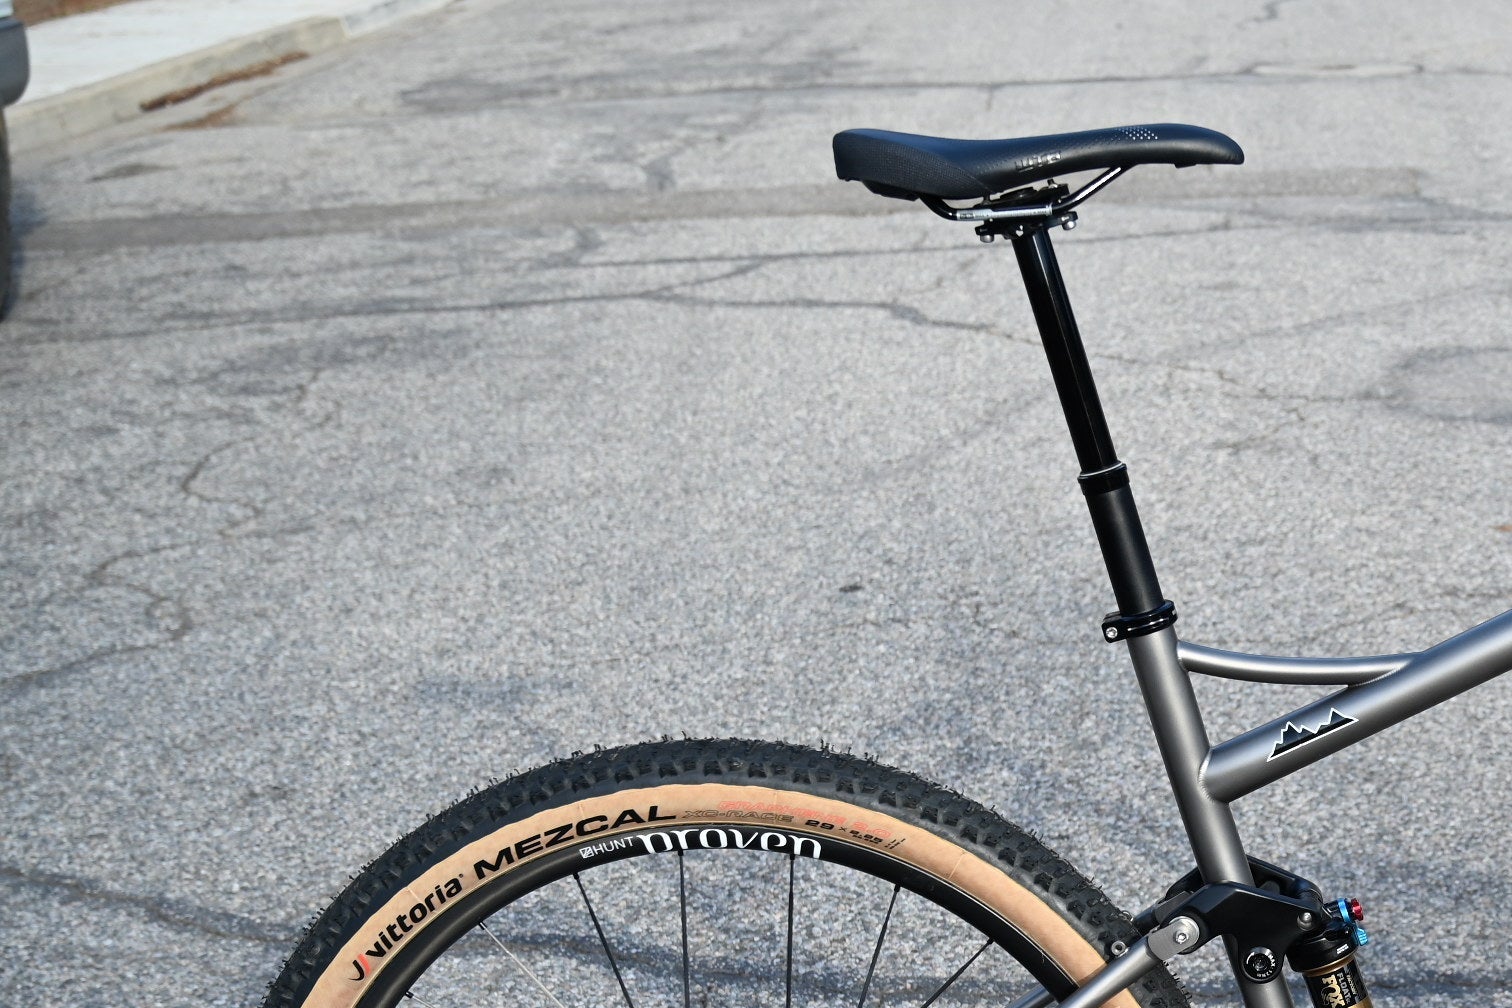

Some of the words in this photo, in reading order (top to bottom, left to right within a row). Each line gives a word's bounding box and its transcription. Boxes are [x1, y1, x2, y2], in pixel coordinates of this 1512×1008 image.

[682, 809, 795, 823] XC-RACE
[805, 819, 835, 831] 29
[473, 806, 677, 880] MEZCAL
[593, 836, 634, 856] HUNT
[636, 829, 822, 860] proven
